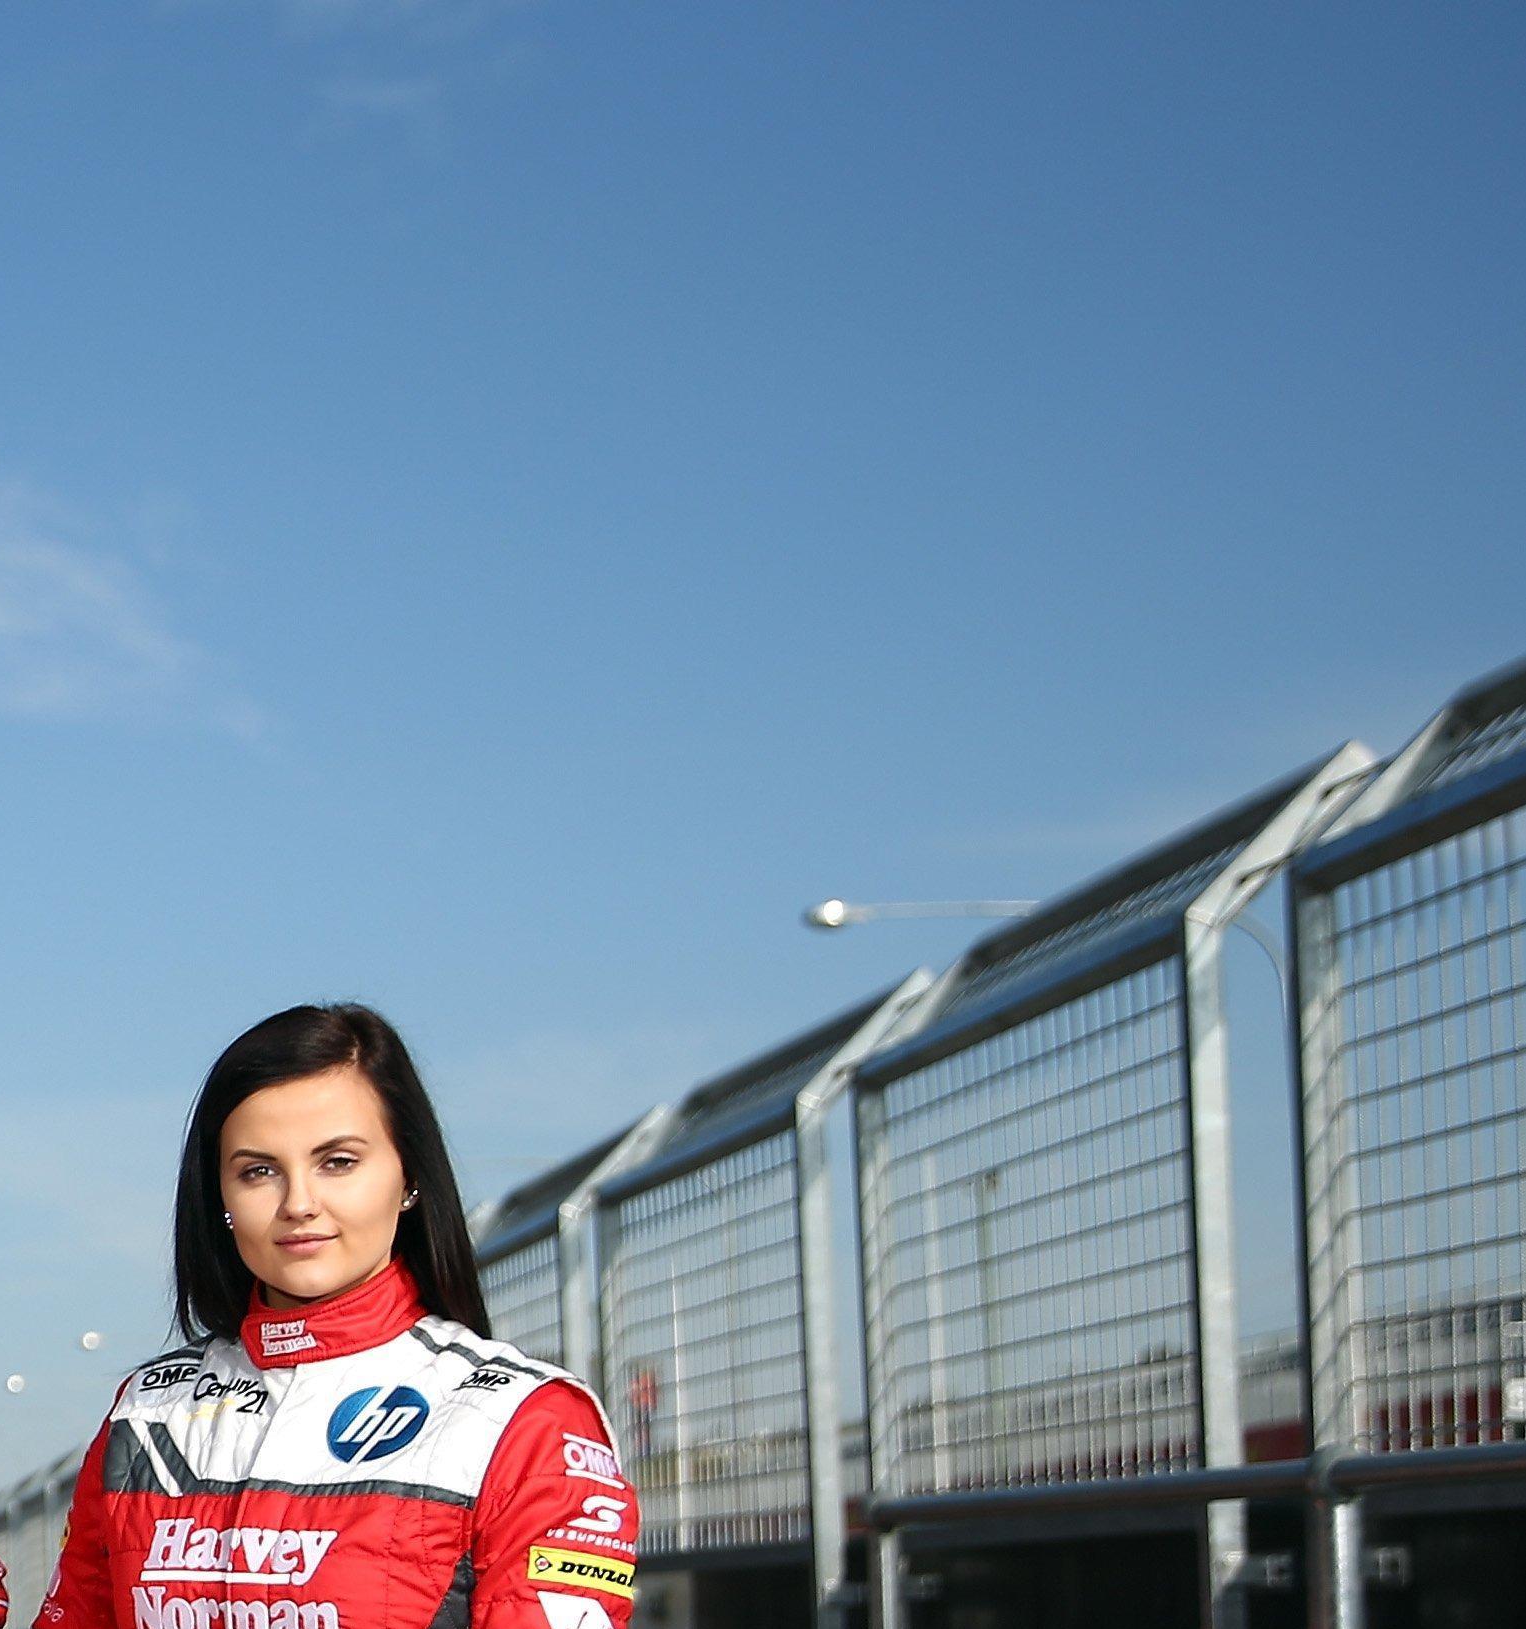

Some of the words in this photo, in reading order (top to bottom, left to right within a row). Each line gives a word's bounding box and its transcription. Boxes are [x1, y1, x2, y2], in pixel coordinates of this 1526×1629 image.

[141, 1367, 199, 1388] OMP
[235, 1390, 269, 1415] 21
[335, 1385, 423, 1464] hp
[143, 1517, 338, 1586] Harvey
